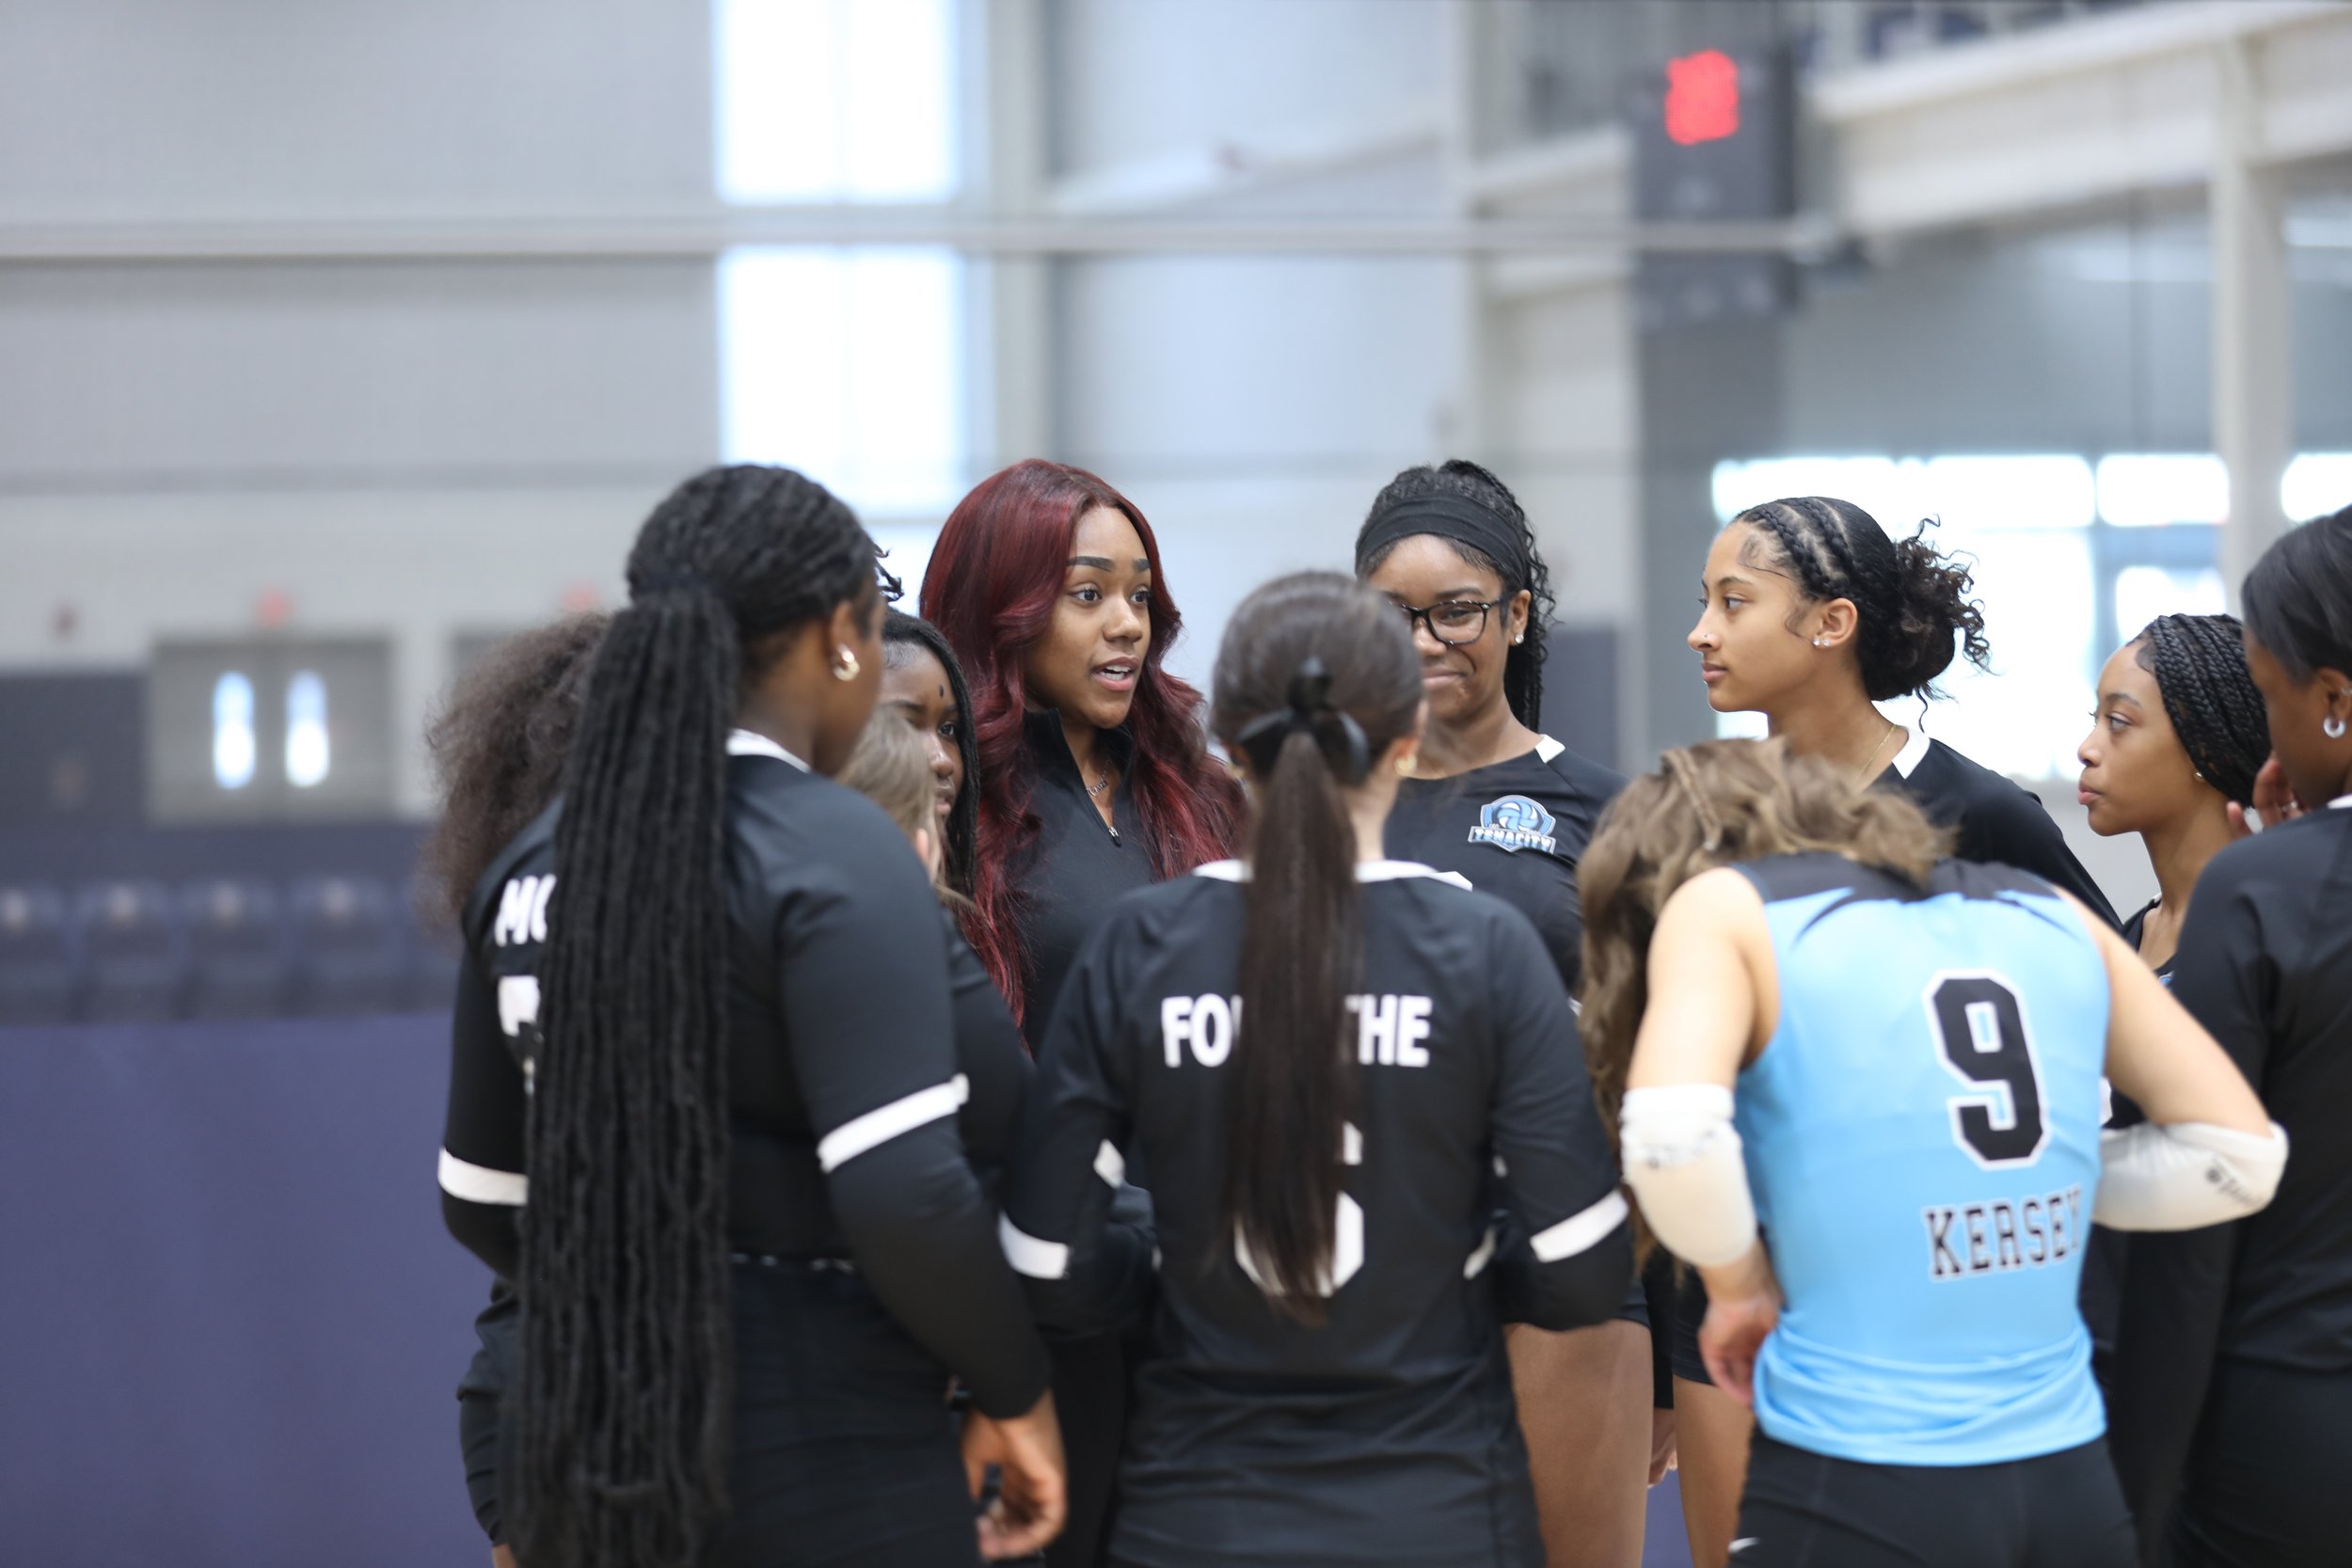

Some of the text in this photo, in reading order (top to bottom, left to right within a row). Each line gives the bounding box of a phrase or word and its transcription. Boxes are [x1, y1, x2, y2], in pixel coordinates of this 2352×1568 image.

[1473, 828, 1551, 852] TENACITY
[1161, 993, 1242, 1068] FO
[1922, 969, 2051, 1170] 9
